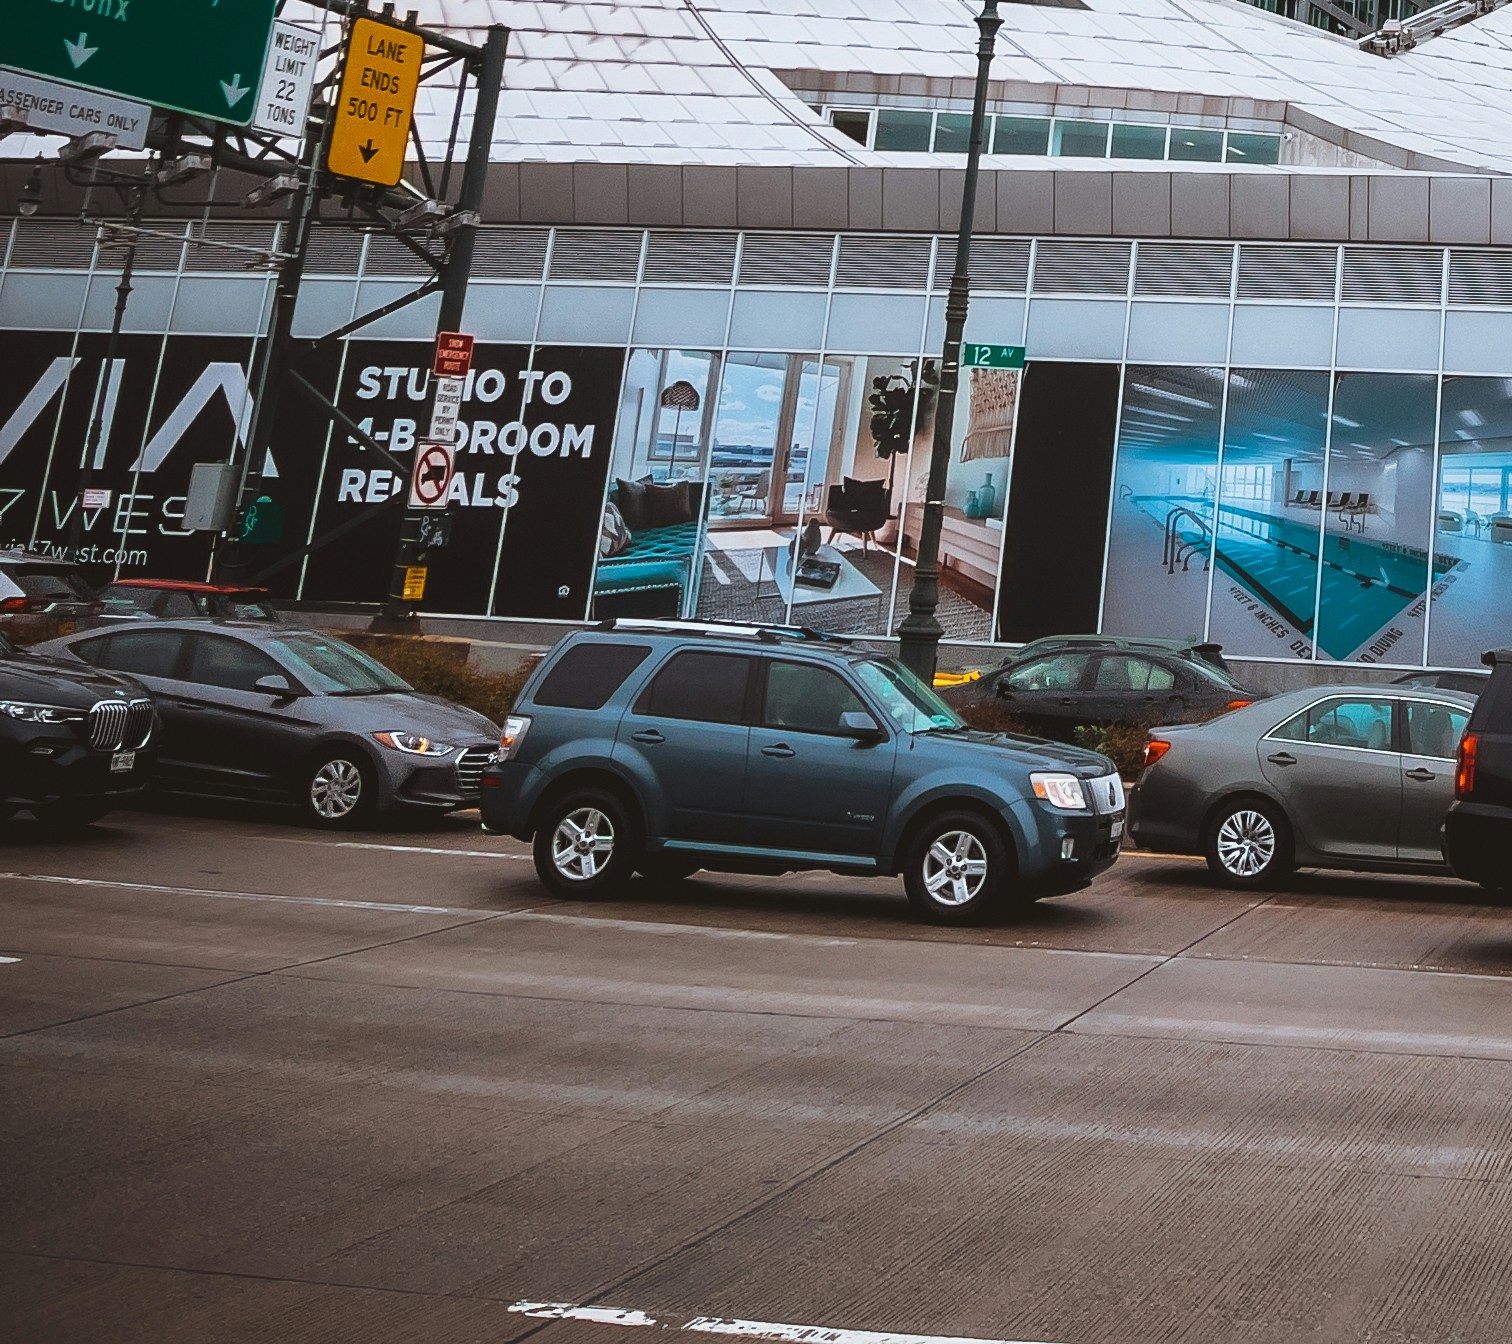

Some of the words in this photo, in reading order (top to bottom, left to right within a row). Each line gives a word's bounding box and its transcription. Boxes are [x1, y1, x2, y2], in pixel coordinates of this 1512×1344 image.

[275, 31, 317, 58] WEIGHT
[366, 35, 408, 64] LANE
[275, 55, 307, 78] LIMIT
[275, 79, 297, 102] 22
[361, 67, 401, 95] ENDS
[69, 104, 102, 124] CARS
[107, 113, 139, 132] ONLY
[266, 103, 297, 126] TONS
[347, 97, 379, 122] 500
[383, 107, 404, 128] FT
[974, 346, 992, 366] 12
[1000, 348, 1015, 358] AV
[356, 366, 506, 403] STUIO
[518, 370, 572, 405] TO
[442, 405, 451, 414] BY
[347, 417, 595, 458] 4-BDROOM
[338, 469, 521, 508] REALS
[51, 490, 227, 538] WES
[1254, 609, 1290, 639] INCHES
[1369, 627, 1404, 658] DIVING
